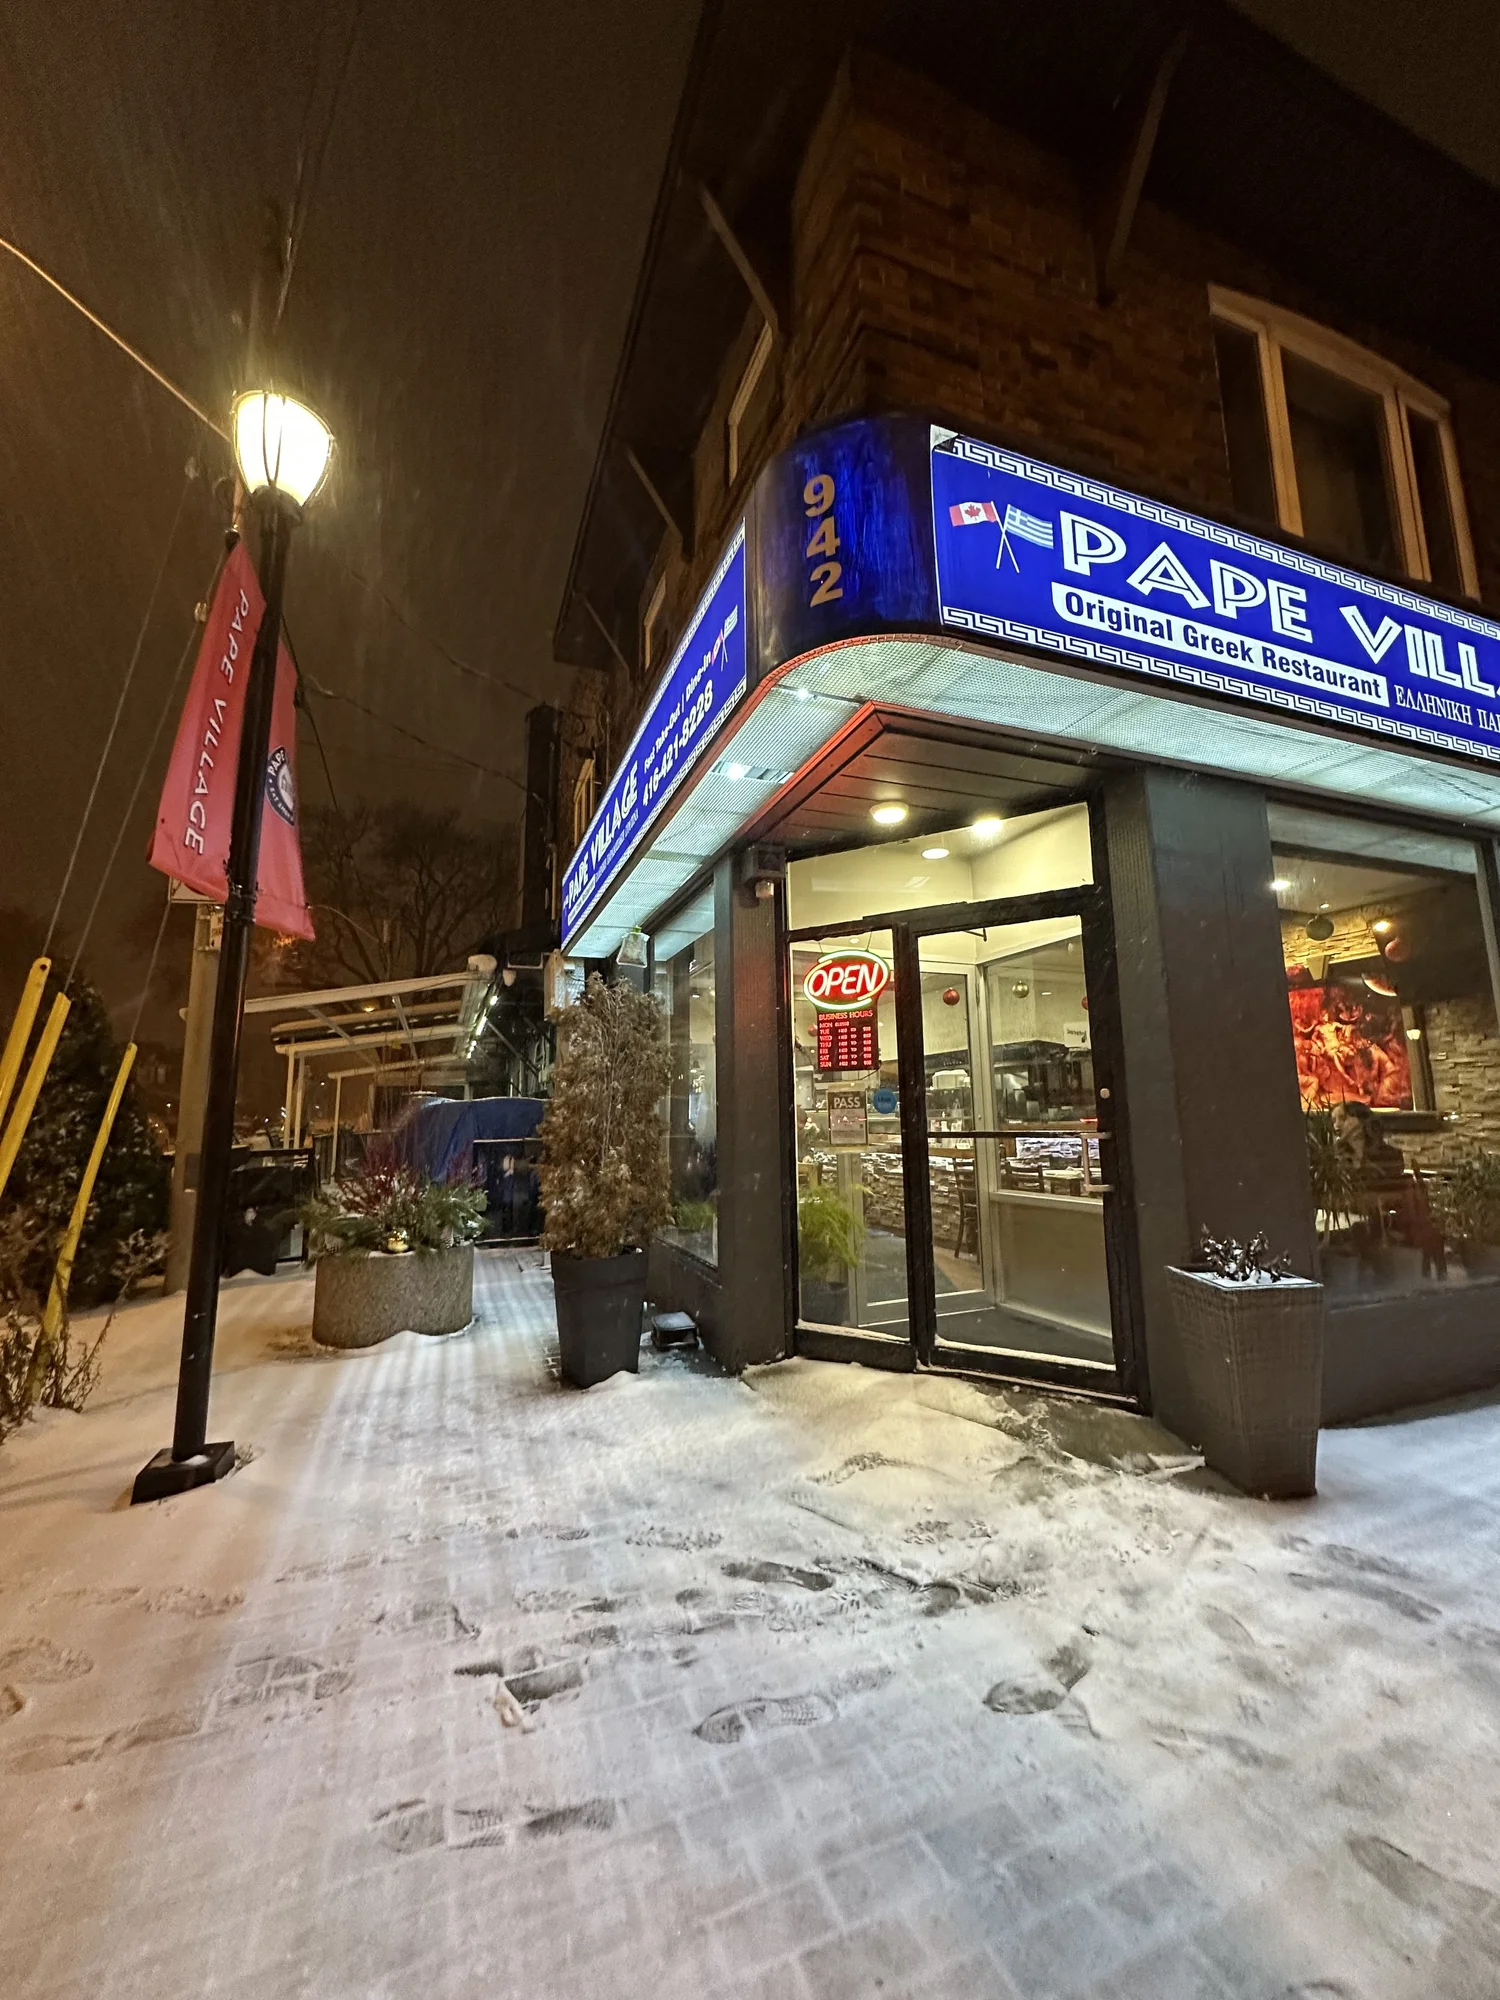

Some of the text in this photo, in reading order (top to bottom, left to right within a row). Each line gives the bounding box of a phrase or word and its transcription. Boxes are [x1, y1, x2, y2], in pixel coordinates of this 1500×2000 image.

[803, 474, 843, 608] 942
[1060, 510, 1500, 699] PAPE VILL
[1065, 590, 1381, 699] Original Greek Restaurant
[185, 588, 249, 855] PAPE VILLAGE
[642, 679, 713, 807] 416-421-8228
[655, 702, 681, 753] Take-Out
[686, 651, 711, 702] Dine-In
[1394, 684, 1473, 726] ΕΛΛΗΝΙΚΗ
[267, 750, 285, 776] PAPE
[568, 851, 589, 909] PAPE
[590, 760, 638, 870] VILLAGE
[808, 963, 879, 997] OPEN
[818, 1010, 873, 1021] BUSINESS HOURS
[833, 1096, 861, 1108] PASS
